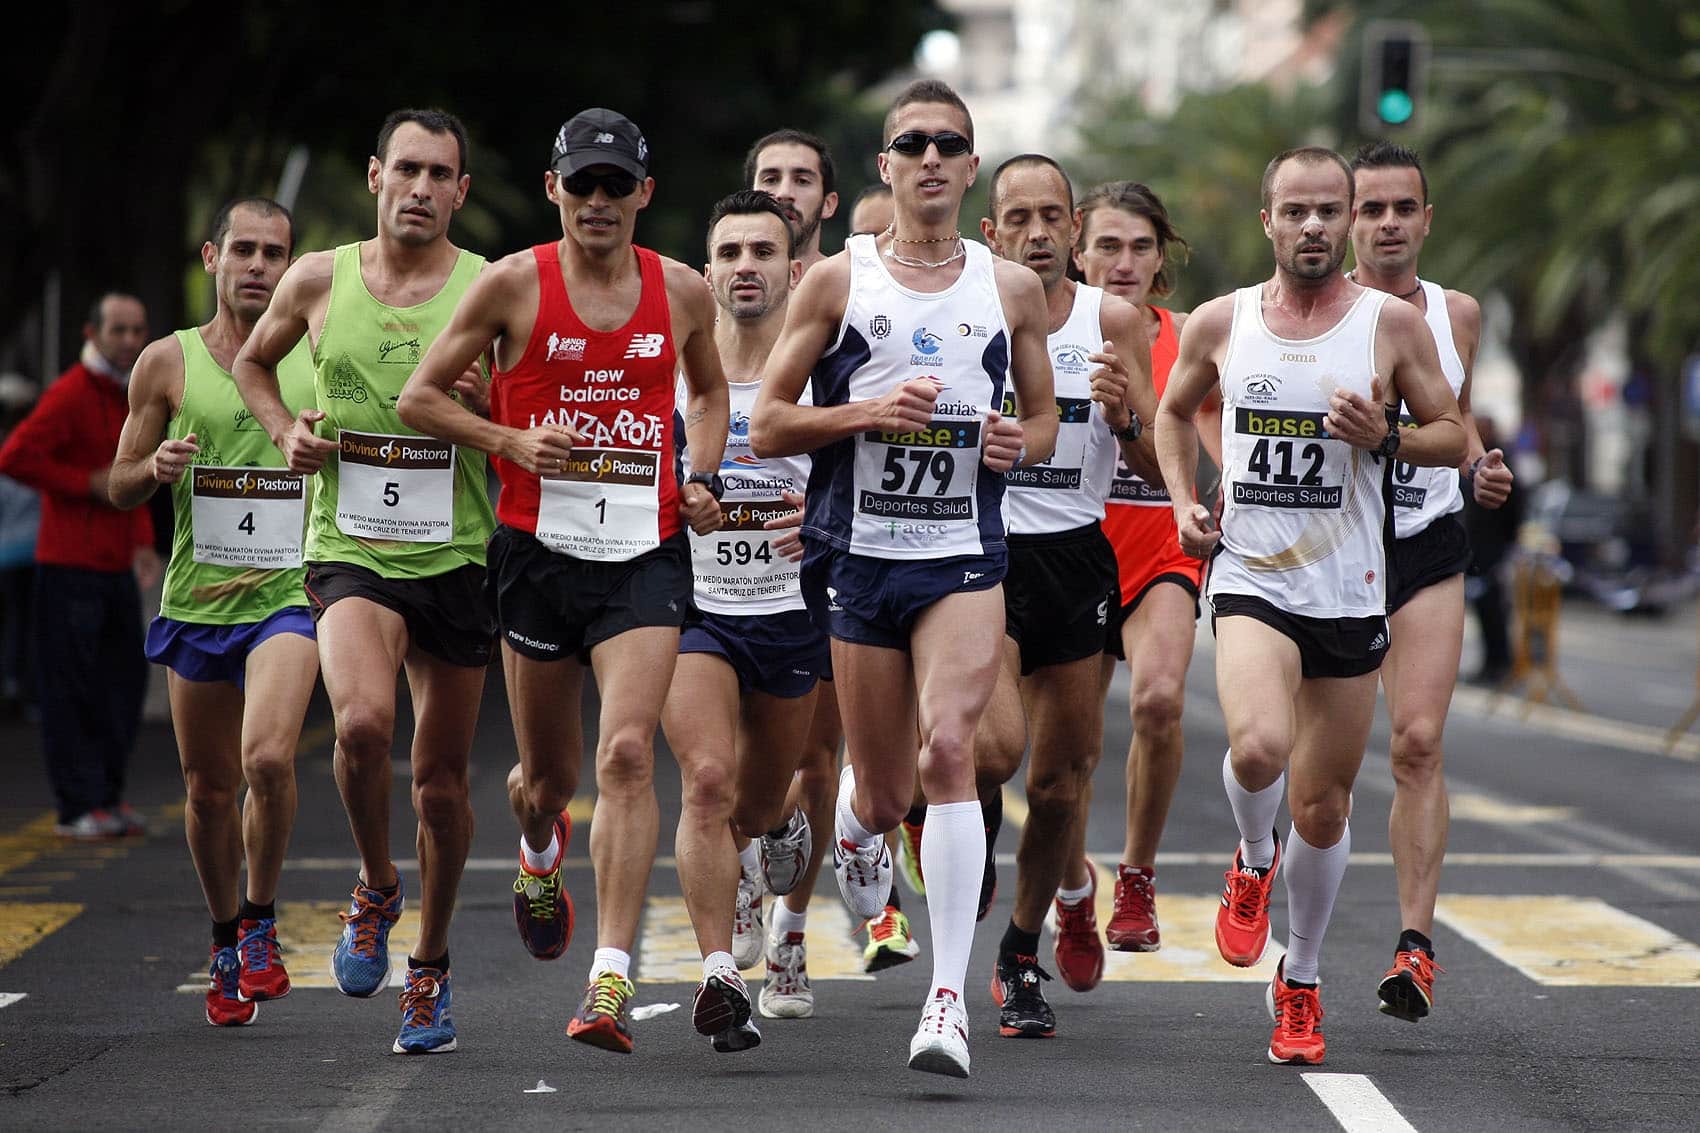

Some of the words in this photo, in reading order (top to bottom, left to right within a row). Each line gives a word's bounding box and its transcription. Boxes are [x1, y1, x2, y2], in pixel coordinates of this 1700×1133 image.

[584, 370, 624, 382] new
[561, 386, 640, 402] balance
[934, 400, 976, 416] arias
[343, 440, 379, 456] Divina
[402, 447, 448, 460] Pastora
[563, 459, 588, 472] vina
[612, 460, 654, 476] Pastora
[1248, 438, 1325, 486] 412
[881, 446, 954, 496] 579
[1005, 470, 1038, 482] ortes
[1042, 470, 1078, 484] Salud
[197, 474, 234, 489] Divina
[257, 478, 300, 490] Pastora
[1112, 483, 1136, 495] rtes
[1140, 484, 1170, 496] Salu
[383, 482, 400, 507] 5
[1236, 486, 1295, 502] Deportes
[1300, 490, 1339, 503] Salud
[595, 498, 606, 524] 1
[864, 495, 928, 515] Deportes
[932, 501, 969, 514] Salud
[238, 512, 255, 535] 4
[350, 514, 366, 522] MEDIO
[550, 533, 572, 541] MEDIO
[903, 524, 947, 534] aecc
[556, 543, 577, 551] SANTA
[716, 541, 772, 566] 594
[703, 576, 721, 584] MEDIO
[754, 576, 773, 584] DIVINA
[758, 584, 786, 594] TENERIFE
[508, 630, 524, 642] new
